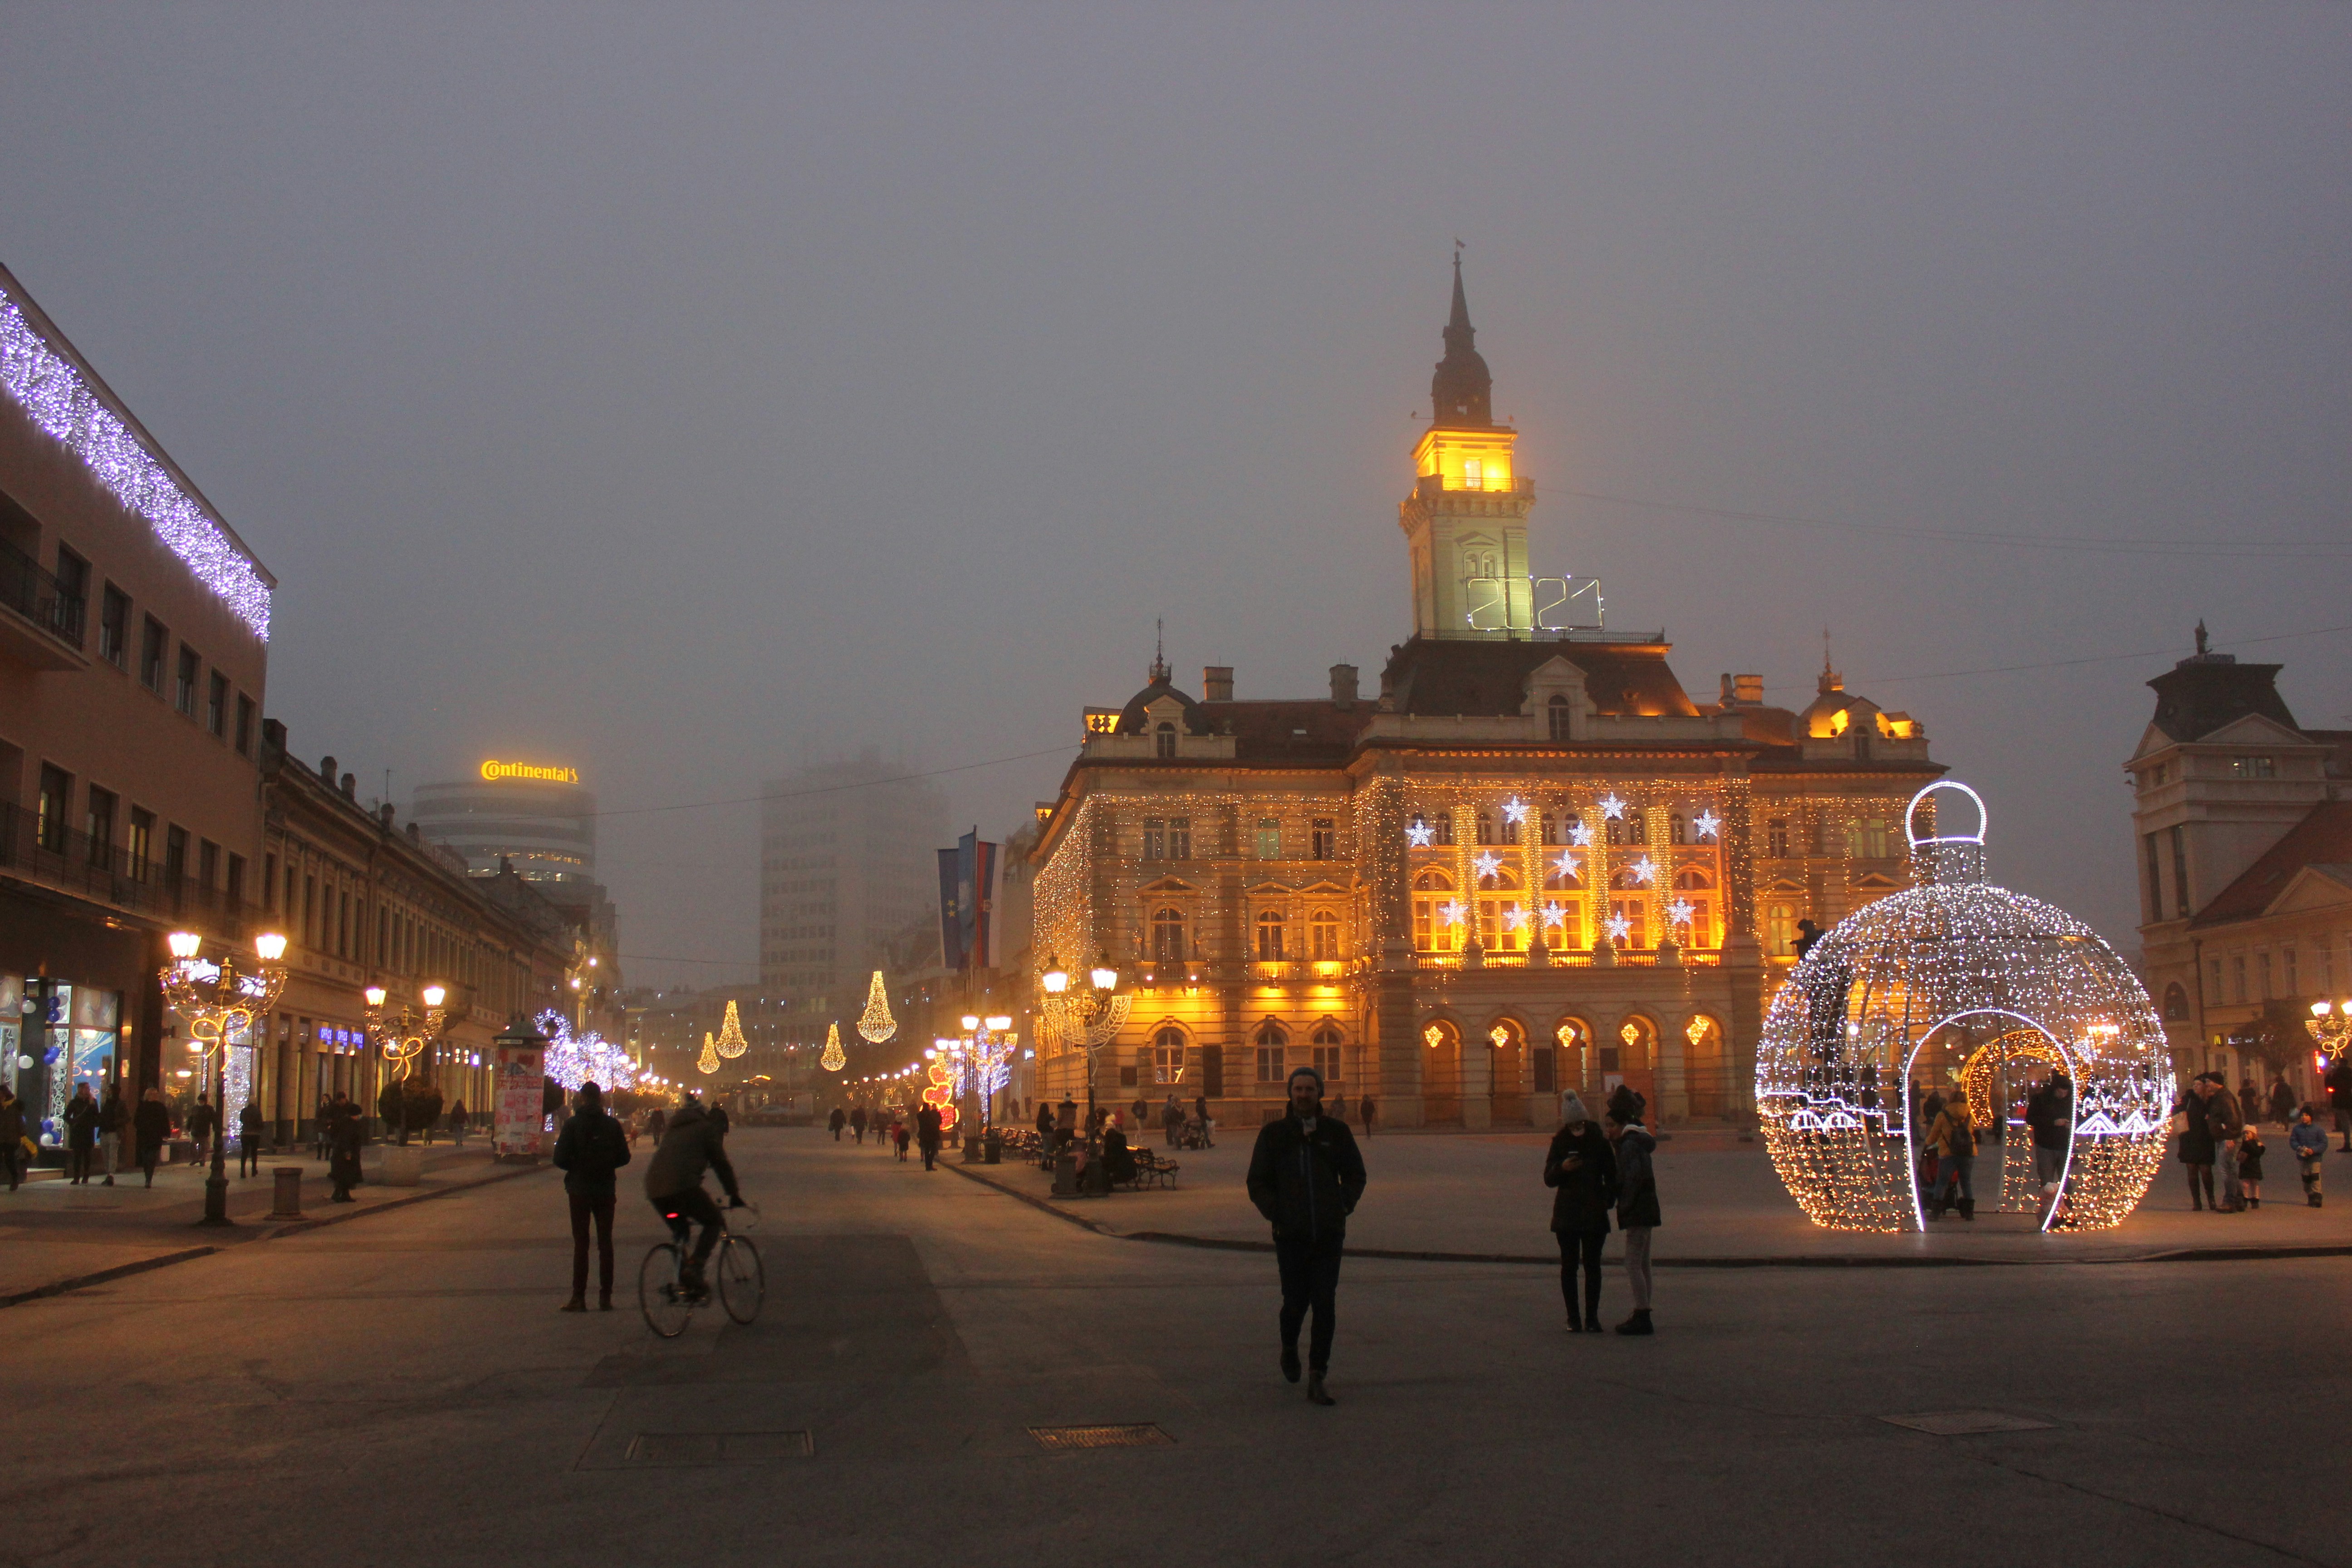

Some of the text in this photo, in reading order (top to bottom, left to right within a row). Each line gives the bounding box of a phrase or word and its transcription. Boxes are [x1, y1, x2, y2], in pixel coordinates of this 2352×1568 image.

[1468, 578, 1603, 630] 2021
[480, 760, 568, 782] Continental
[321, 1028, 332, 1040] OFFICE
[338, 1030, 348, 1041] OFFICE
[353, 1033, 363, 1044] OFFICE
